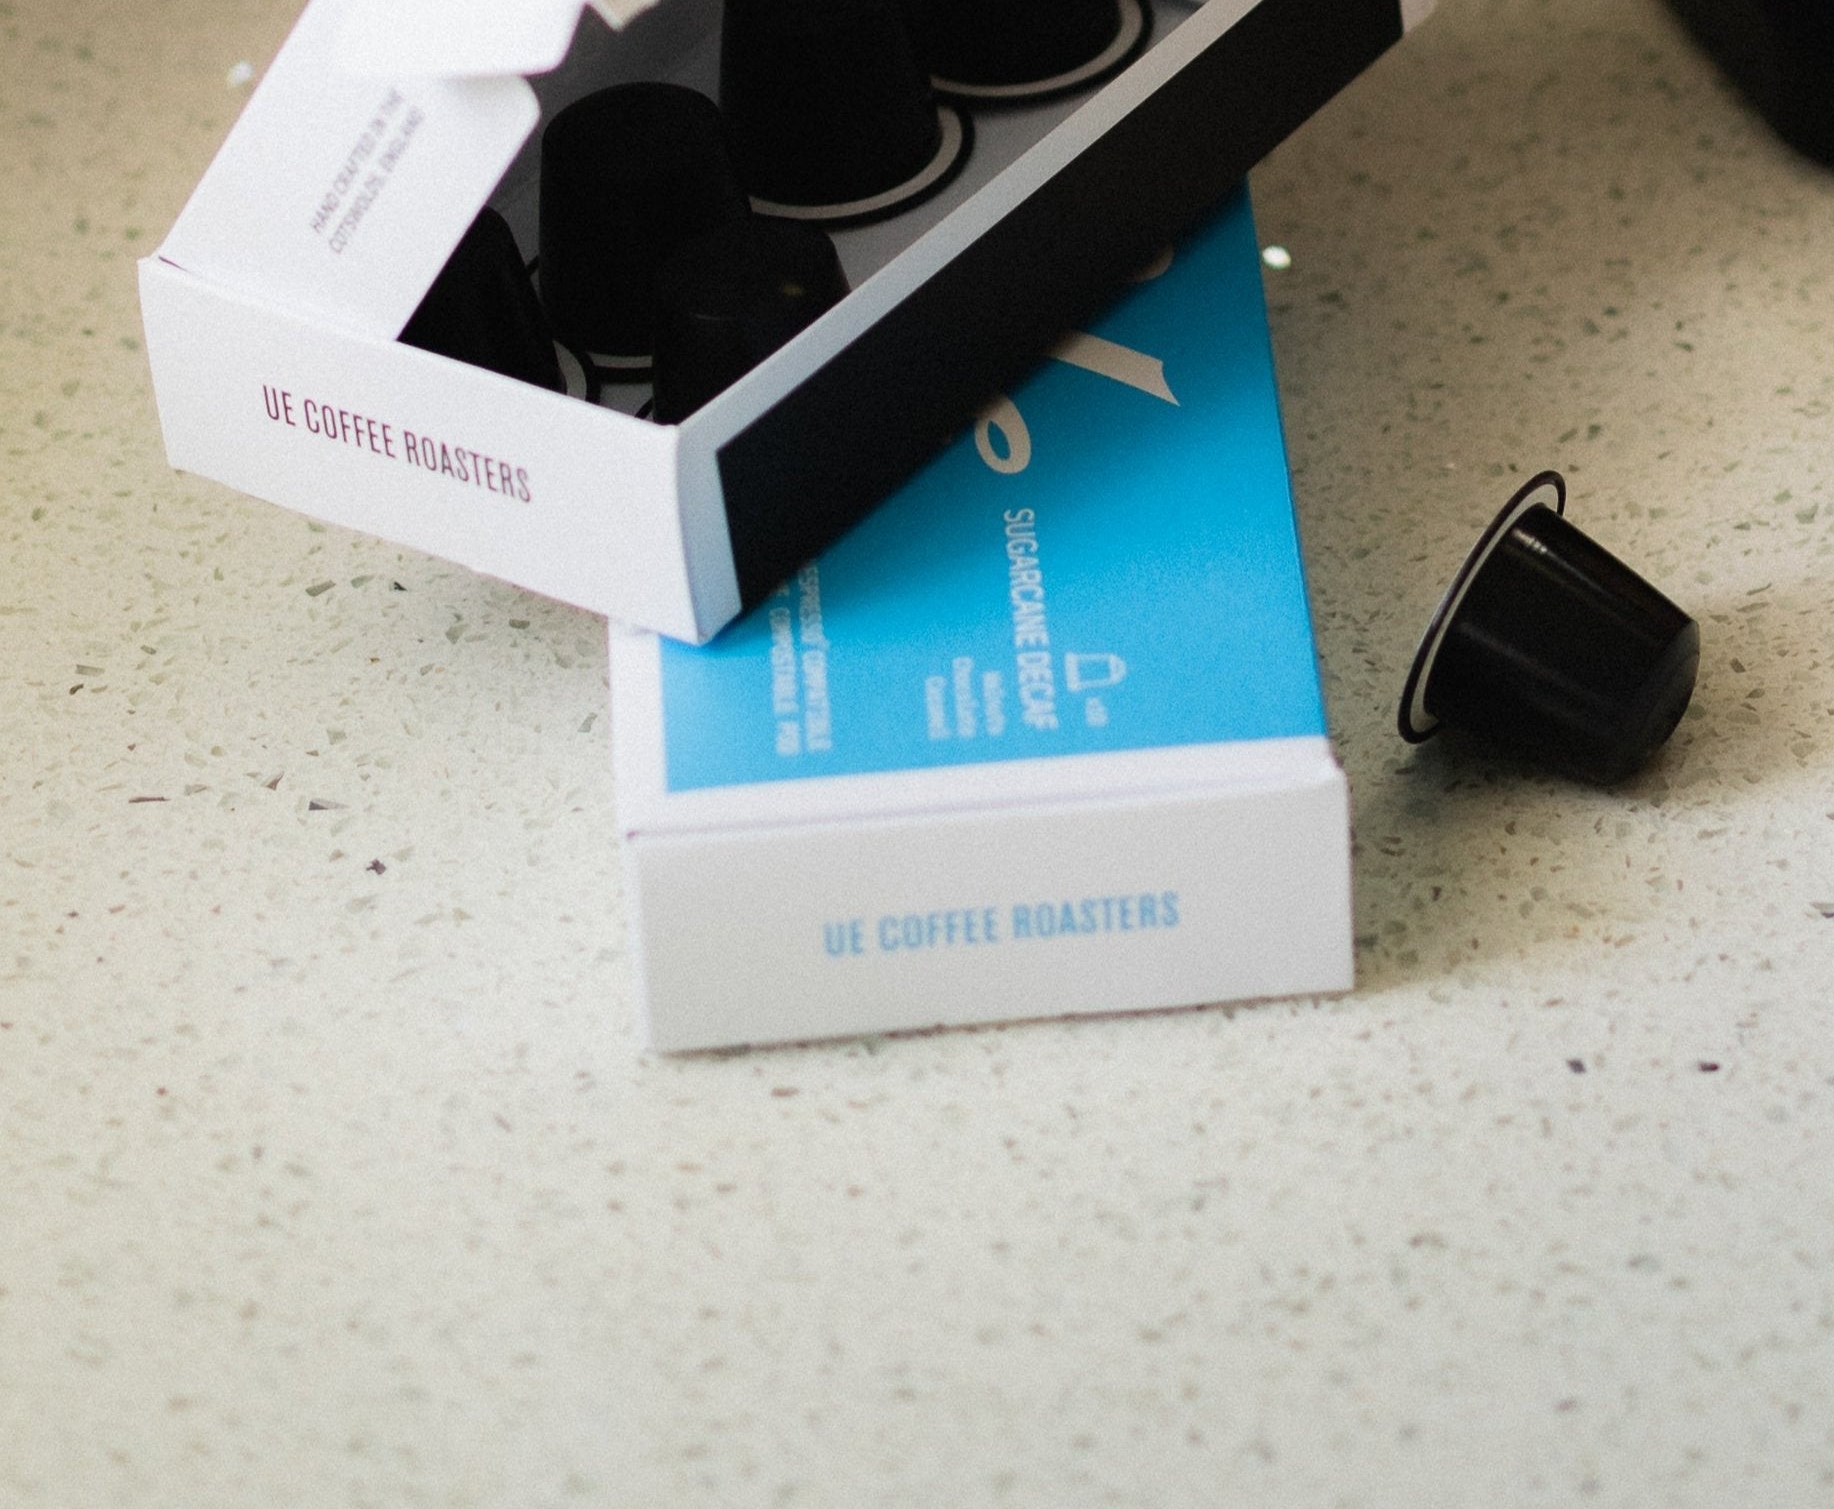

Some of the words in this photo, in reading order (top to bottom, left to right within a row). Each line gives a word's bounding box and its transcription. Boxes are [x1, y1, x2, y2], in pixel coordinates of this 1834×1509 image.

[310, 191, 340, 234] HAND
[263, 383, 296, 427] UE
[303, 397, 397, 459] COFFEE
[403, 429, 532, 503] ROASTERS
[1003, 507, 1051, 650] SUGARCANE
[1016, 651, 1060, 731] DECAF
[823, 917, 865, 958] UE
[876, 895, 999, 951] COFFEE
[1012, 879, 1181, 939] ROASTERS
